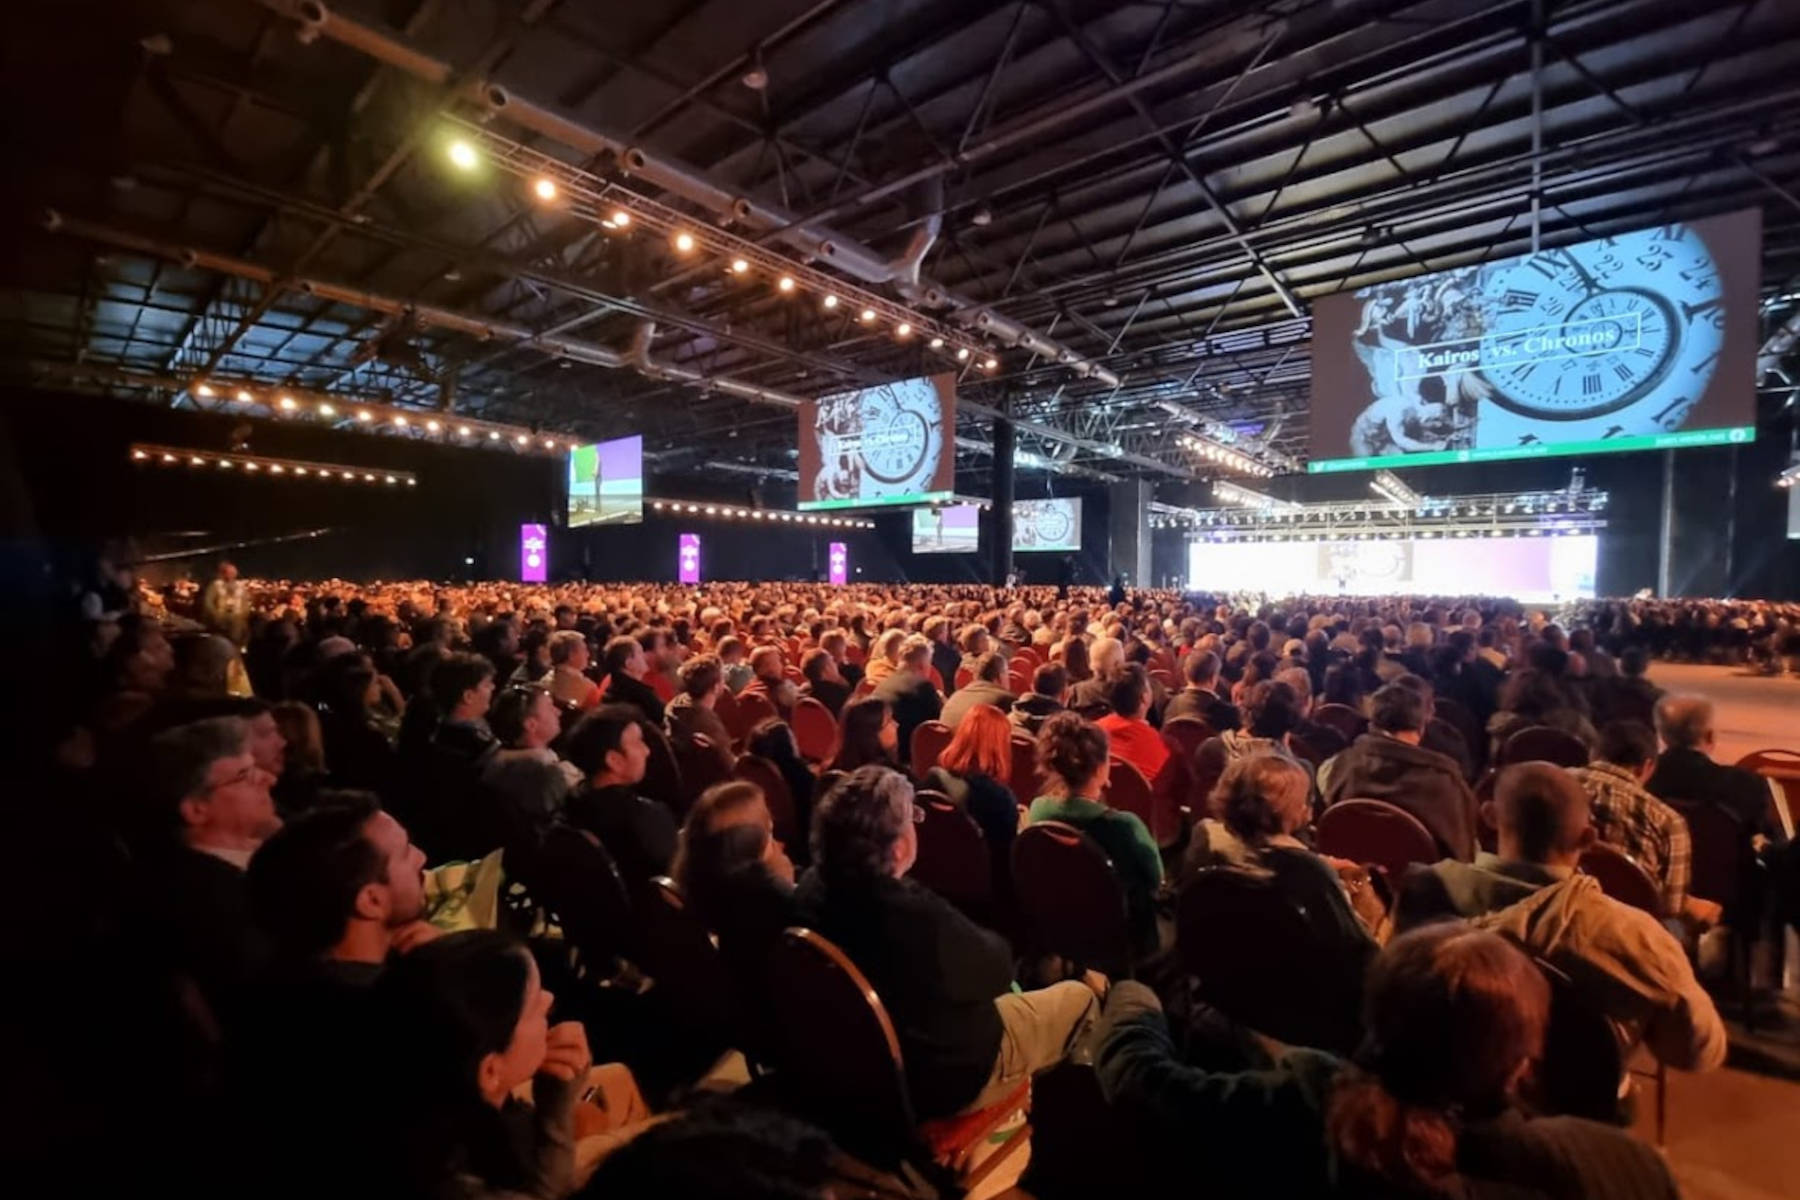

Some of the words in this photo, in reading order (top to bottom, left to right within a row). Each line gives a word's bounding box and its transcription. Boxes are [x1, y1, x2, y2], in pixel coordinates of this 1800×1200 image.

[1593, 254, 1624, 280] 22
[1419, 350, 1480, 369] Kairos
[1492, 345, 1517, 358] vs.
[1524, 328, 1615, 354] Chronos
